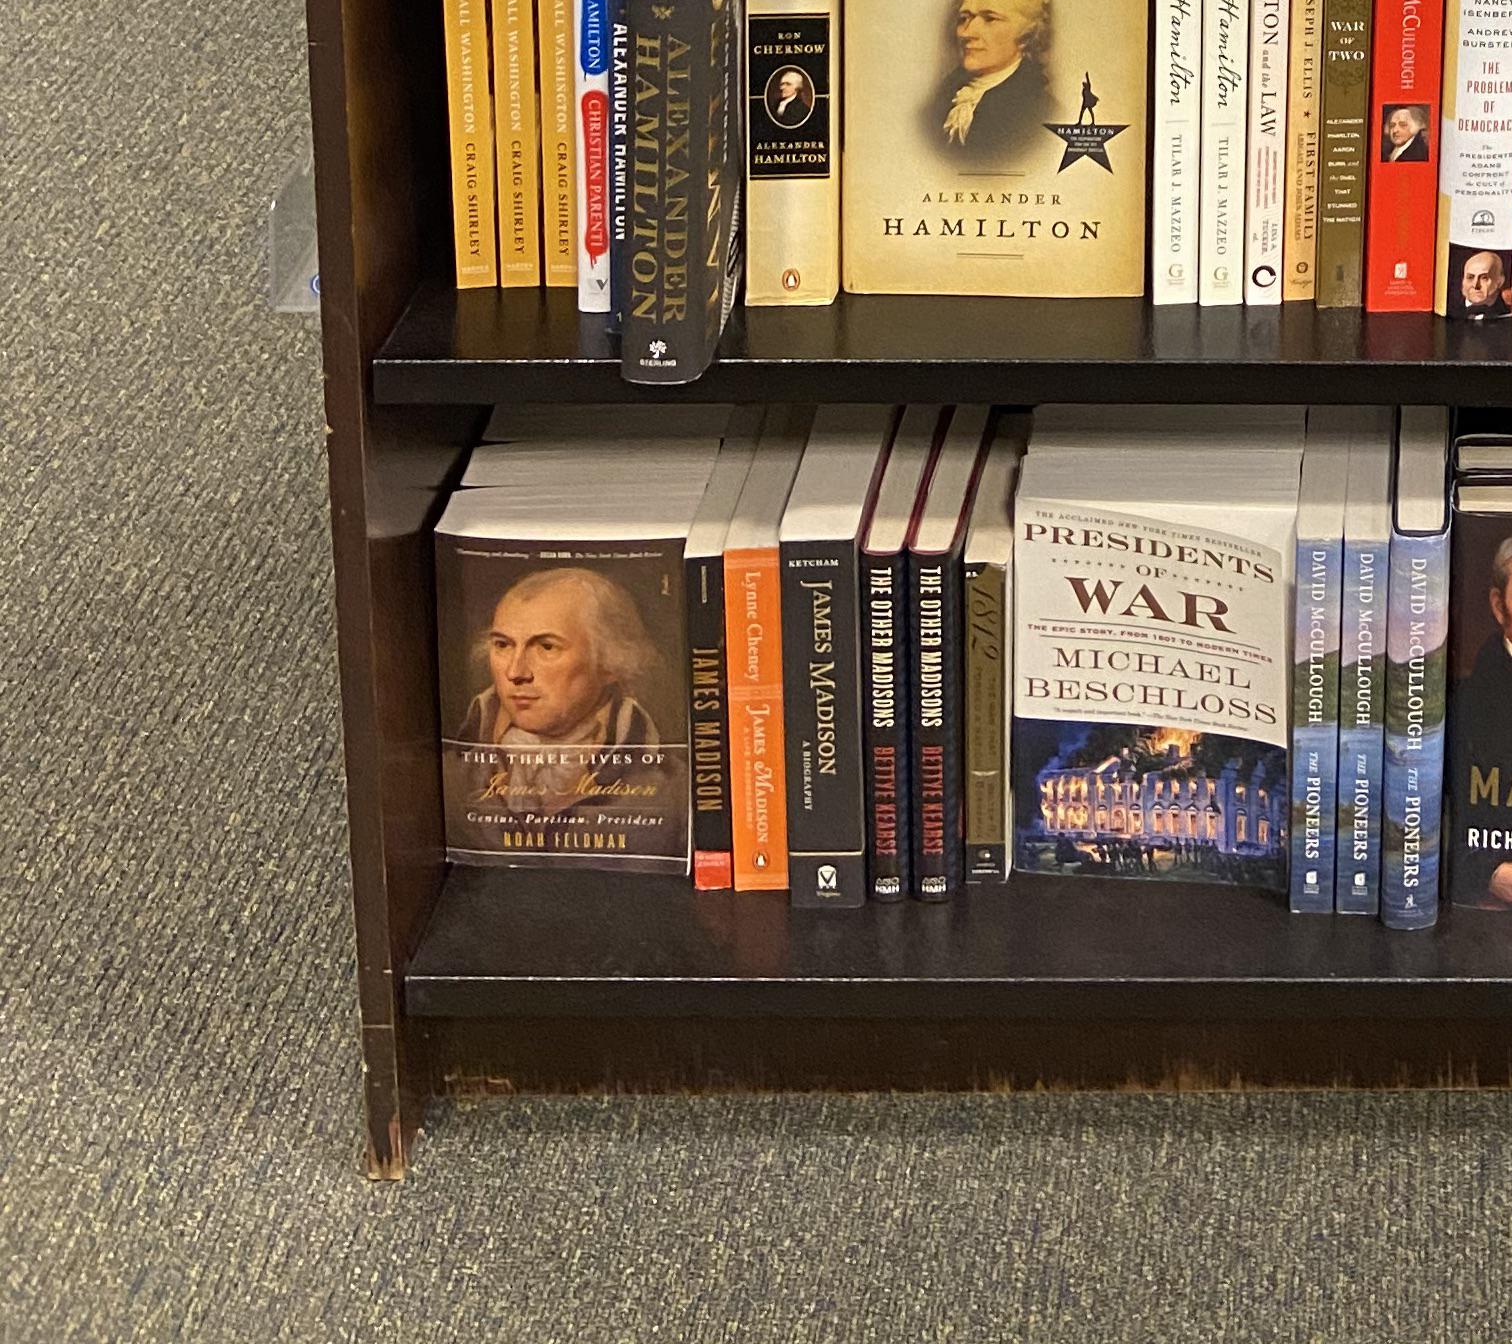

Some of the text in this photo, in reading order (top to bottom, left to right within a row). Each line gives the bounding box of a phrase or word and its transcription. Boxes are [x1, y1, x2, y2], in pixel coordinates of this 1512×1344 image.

[1331, 21, 1365, 32] WAR
[778, 32, 801, 40] RON
[754, 44, 825, 55] CHERNOW
[1328, 50, 1365, 62] TWO
[1482, 62, 1499, 74] THE
[1466, 79, 1512, 94] PROBLEM
[1483, 100, 1496, 113] OF
[923, 193, 1061, 205] ALEXANDER
[883, 219, 1101, 239] HAMILTON
[1023, 523, 1275, 584] PRESIDENTS
[1136, 565, 1168, 579] OF
[1064, 576, 1235, 634] WAR
[1055, 647, 1251, 690] MICHAEL
[801, 580, 836, 775] JAMES MADISON
[1025, 678, 1278, 725] BESCHLOSS
[462, 752, 665, 766] THE THREE LIVES OF
[503, 831, 626, 849] NOAH FELDMAN
